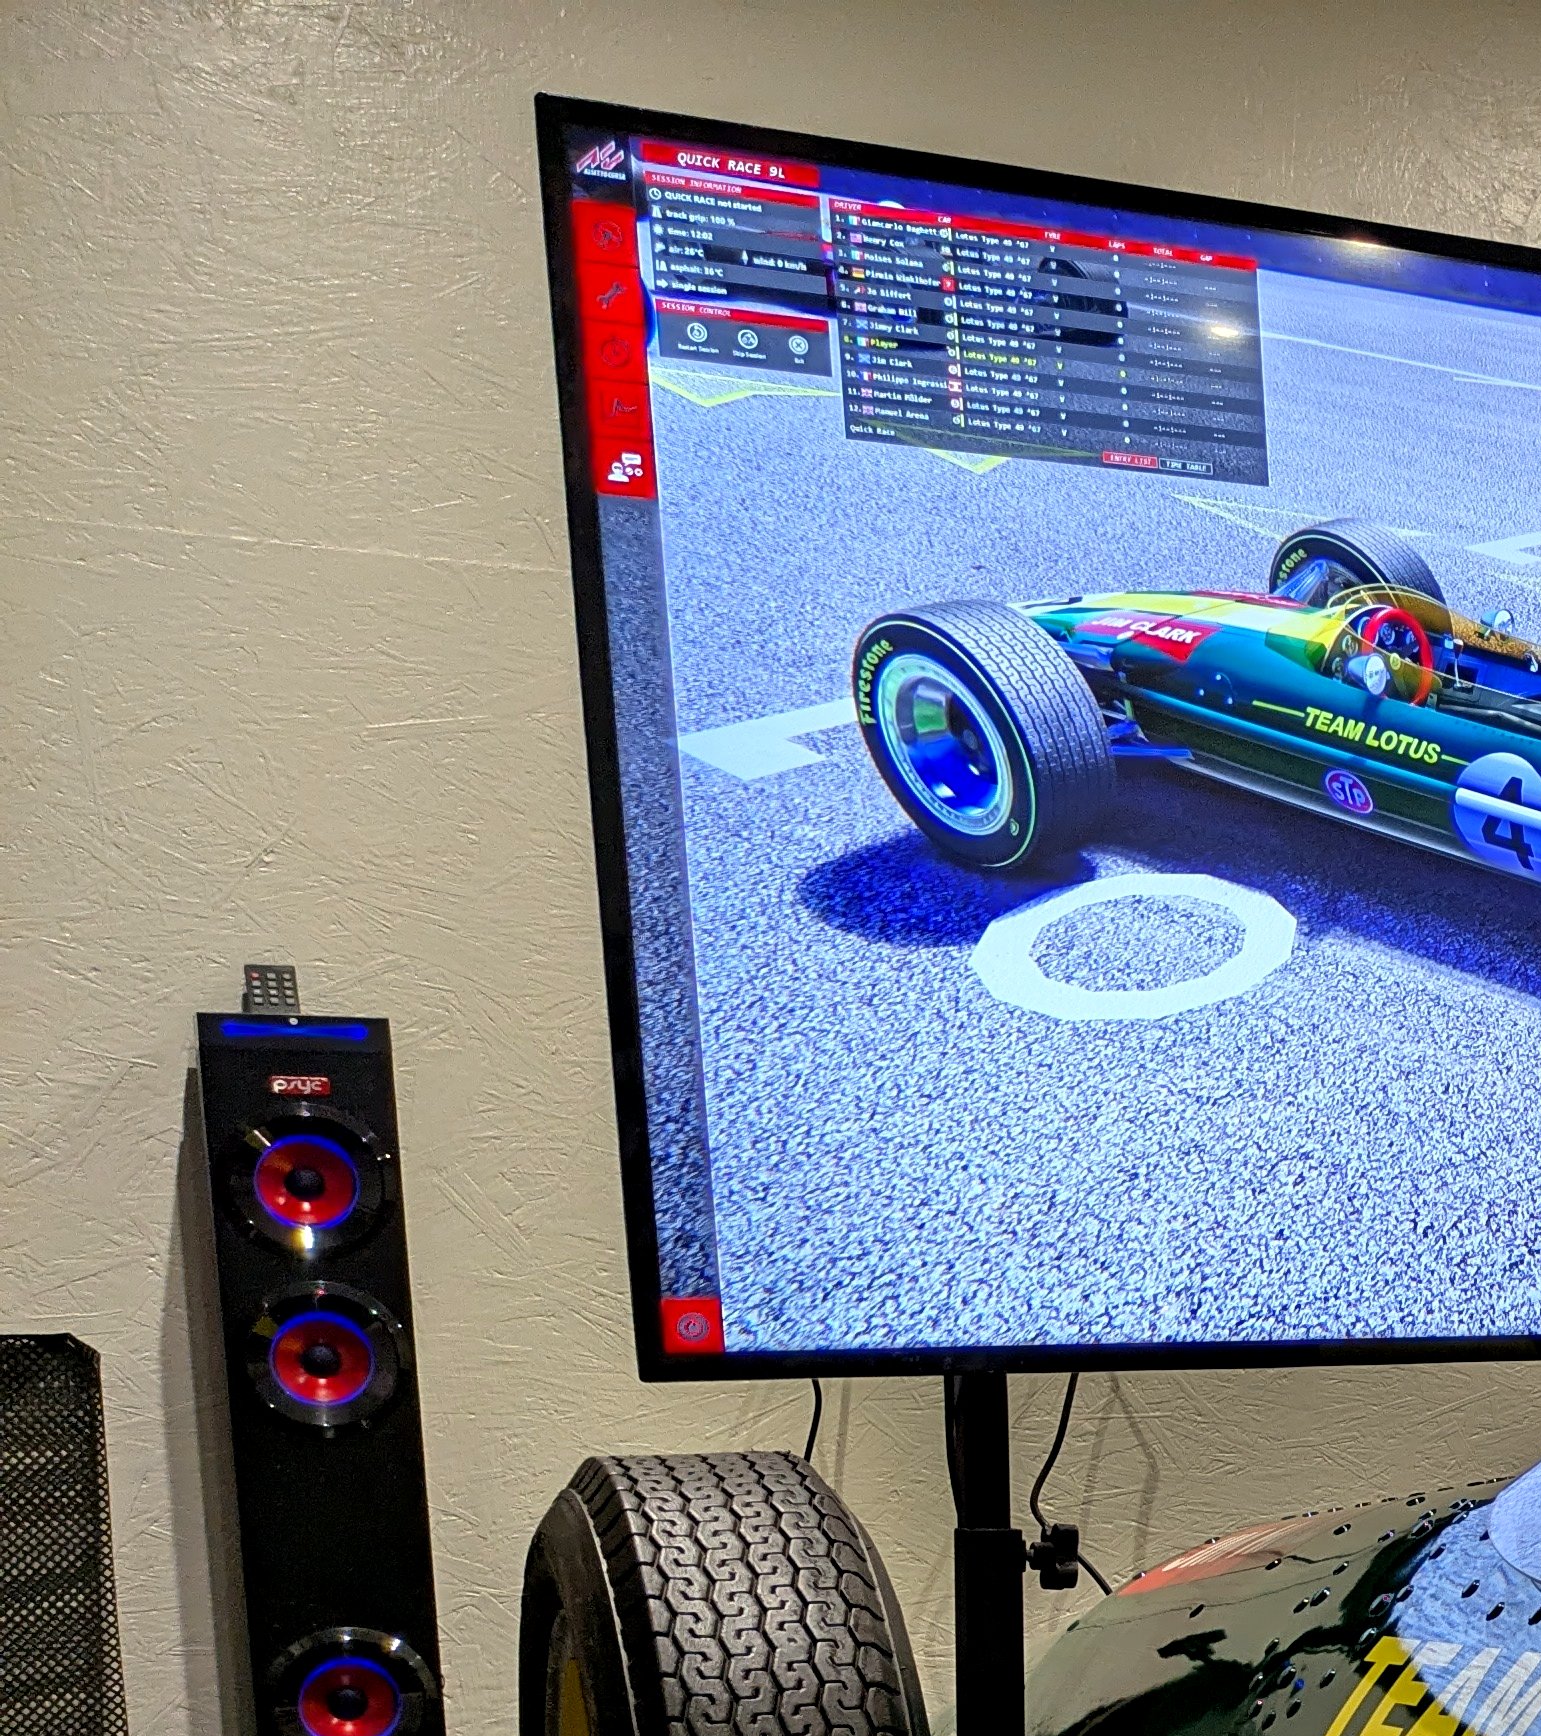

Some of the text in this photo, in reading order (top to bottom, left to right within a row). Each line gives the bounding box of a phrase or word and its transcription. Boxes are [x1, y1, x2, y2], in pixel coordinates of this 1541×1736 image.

[677, 152, 785, 179] QUICK RACE 9L
[651, 174, 742, 194] SESSION INFORMATION
[664, 191, 762, 213] QUICK RACE not started
[666, 209, 687, 220] track
[667, 227, 689, 238] time:
[834, 201, 862, 211] DRIVER
[1153, 247, 1173, 257] TOTAL
[861, 218, 904, 232] Giancarlo
[955, 231, 979, 242] Lotus
[981, 235, 1000, 245] Type
[956, 248, 980, 259] Lotus
[982, 252, 1001, 262] Type
[957, 265, 981, 276] Lotus
[983, 269, 1002, 279] Type
[672, 281, 728, 295] single session
[958, 282, 982, 293] Lotus
[984, 286, 1003, 296] Type
[661, 301, 732, 317] SESSION CONTROL
[867, 304, 896, 315] Graham
[960, 316, 984, 327] Lotus
[987, 319, 1005, 330] Type
[960, 300, 983, 310] Lotus
[985, 303, 1004, 313] Type
[895, 325, 919, 336] Clark
[962, 333, 985, 344] Lotus
[988, 336, 1006, 347] Type
[870, 338, 898, 350] Player
[963, 350, 986, 360] Lotus
[989, 353, 1007, 364] Type
[872, 356, 887, 365] Jim
[889, 358, 913, 368] Clark
[964, 367, 988, 377] Lotus
[990, 371, 1008, 381] Type
[965, 384, 988, 394] Lotus
[991, 387, 1009, 397] Type
[873, 391, 902, 400] Martin
[966, 400, 990, 411] Lotus
[992, 404, 1010, 414] Type
[849, 425, 873, 435] Quick
[968, 417, 991, 428] Lotus
[993, 421, 1012, 430] Type
[1134, 455, 1152, 466] LIST
[1277, 548, 1308, 582] stone
[1129, 621, 1203, 644] CLARK
[858, 639, 893, 725] Firestone
[1304, 706, 1441, 764] TEAM LOTUS
[1331, 775, 1366, 807] STP
[1481, 776, 1535, 872] 4
